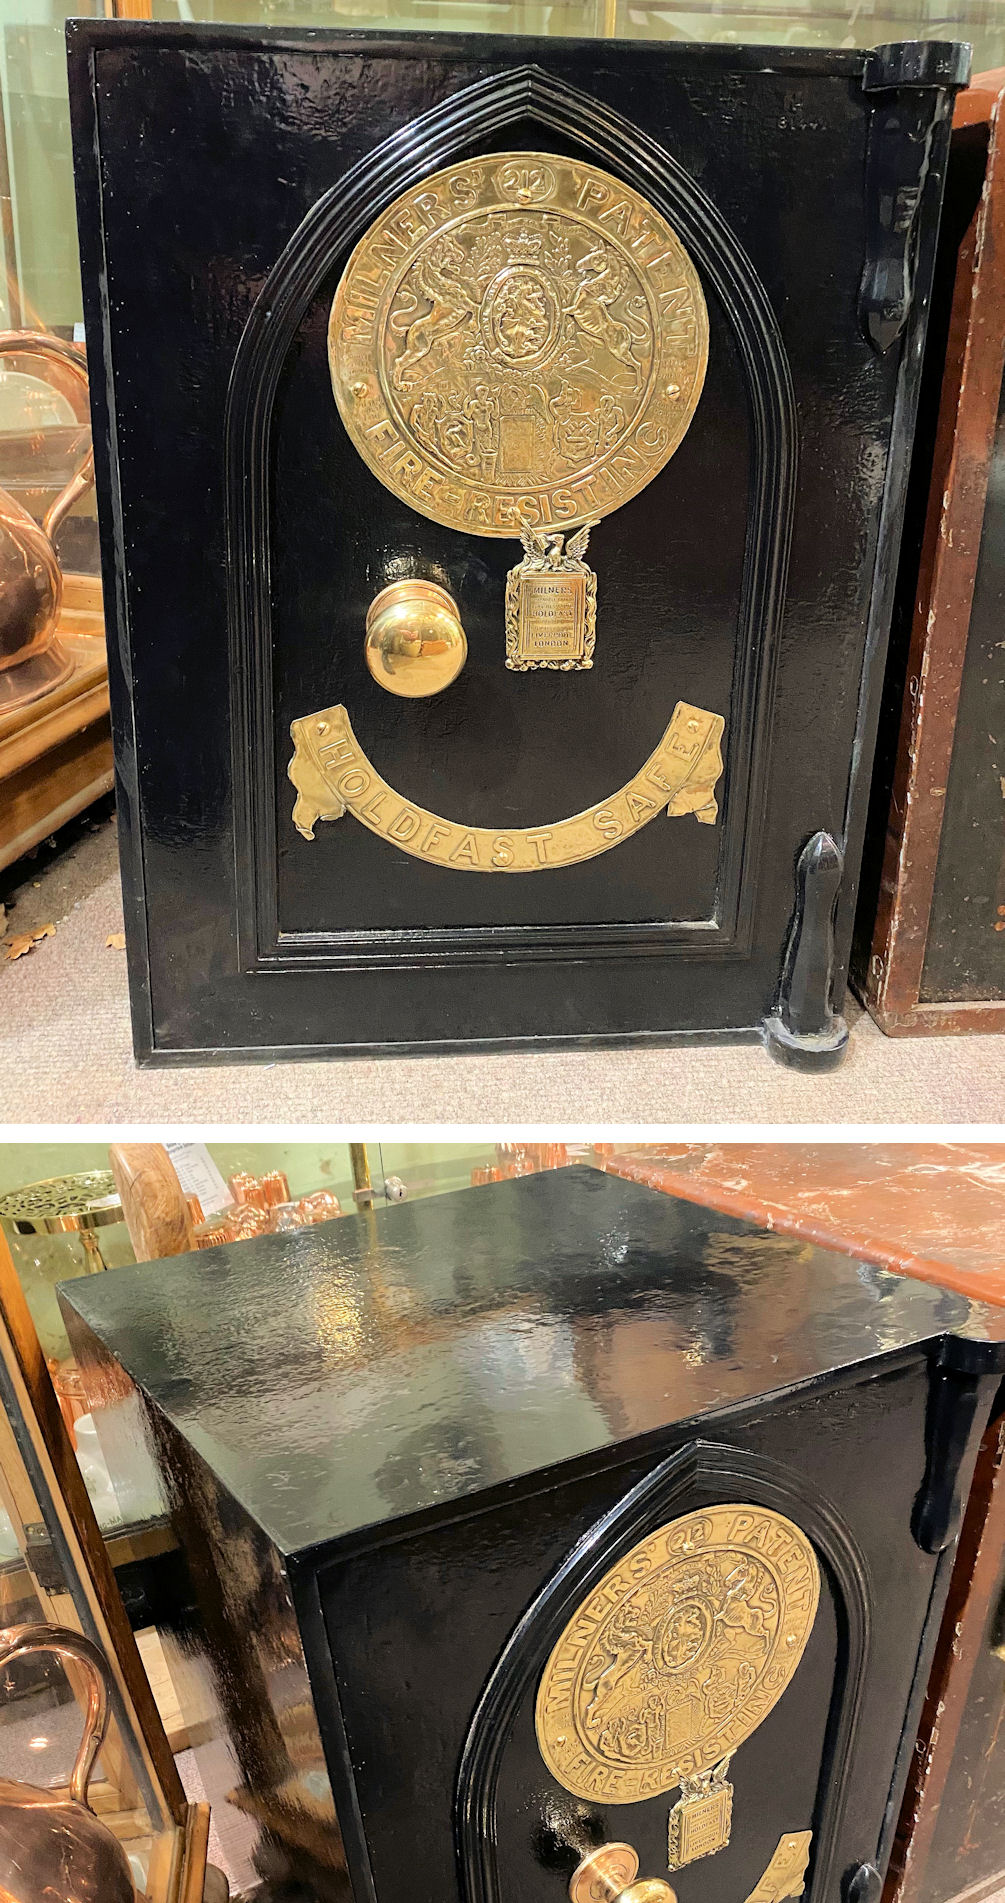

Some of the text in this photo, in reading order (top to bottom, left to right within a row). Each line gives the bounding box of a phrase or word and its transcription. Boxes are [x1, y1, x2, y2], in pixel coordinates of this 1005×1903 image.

[576, 177, 698, 358] PATENT
[318, 733, 700, 868] HOLDFAST SAFE
[728, 1514, 812, 1612] PATENT
